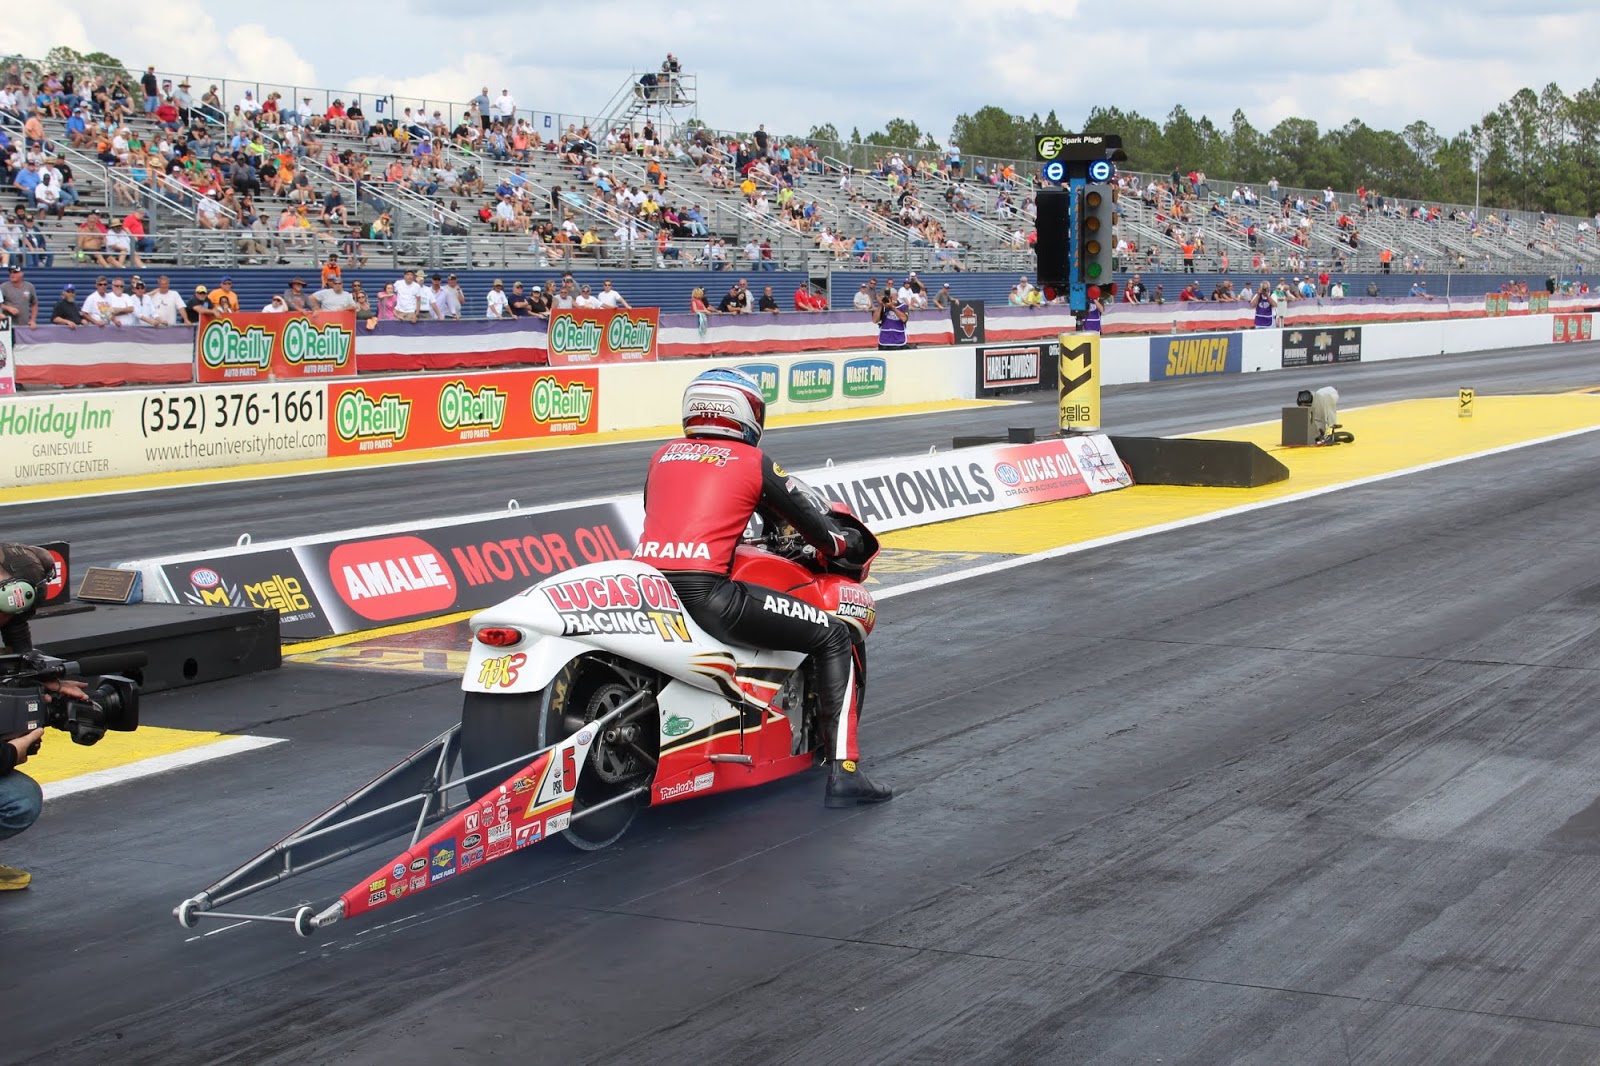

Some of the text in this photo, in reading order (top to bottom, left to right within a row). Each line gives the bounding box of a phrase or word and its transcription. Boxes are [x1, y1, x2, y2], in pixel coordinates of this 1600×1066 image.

[1062, 137, 1082, 145] Spark
[1083, 136, 1103, 144] Plugs
[284, 319, 350, 365] O'Reilly
[553, 315, 601, 354] O'Reilly
[609, 315, 654, 353] O'Reilly
[203, 321, 273, 367] O'Reilly
[1166, 338, 1229, 376] SUNOCO
[224, 367, 257, 378] AUTO PARTS
[304, 364, 334, 374] AUTO PARTS
[846, 365, 883, 384] WASTE PRO
[987, 354, 1037, 380] HARLEY-DAVIDSON
[761, 371, 776, 389] PRO
[792, 368, 831, 387] WASTE PRO
[441, 384, 506, 429] O'Reilly
[533, 379, 592, 423] O'Reilly
[690, 402, 734, 414] ARANA
[0, 401, 112, 439] Holiday Inn
[141, 389, 325, 437] (352) 376-1661
[338, 391, 409, 438] O'Reilly
[460, 429, 489, 440] AUTO PARTS
[550, 422, 577, 432] AUTO PARTS
[33, 440, 93, 457] GAINESVILLE
[146, 431, 327, 462] www.theuniversityhotel.com
[359, 439, 392, 451] AUTO PARTS
[667, 443, 731, 458] LUCAS OIL
[15, 458, 110, 478] UNIVERSITY CENTER
[659, 453, 720, 464] RACING TV
[1017, 455, 1058, 483] LUCAS
[1055, 453, 1079, 476] OIL
[1005, 478, 1085, 496] DRAG RACING SERIES
[632, 542, 710, 560] ARANA
[342, 525, 635, 600] AMALIE MOTOR OIL
[193, 571, 217, 585] NHRA
[244, 575, 301, 602] Mello
[544, 574, 682, 612] LUCAS OIL
[840, 586, 867, 607] LUCAS
[298, 611, 316, 620] SERIES
[763, 595, 830, 627] ARANA
[838, 604, 867, 619] RACING
[563, 611, 693, 642] RACING TV
[563, 746, 577, 792] 5
[466, 813, 478, 829] CV
[432, 850, 454, 866] SUNOCO
[369, 891, 386, 903] JESEL
